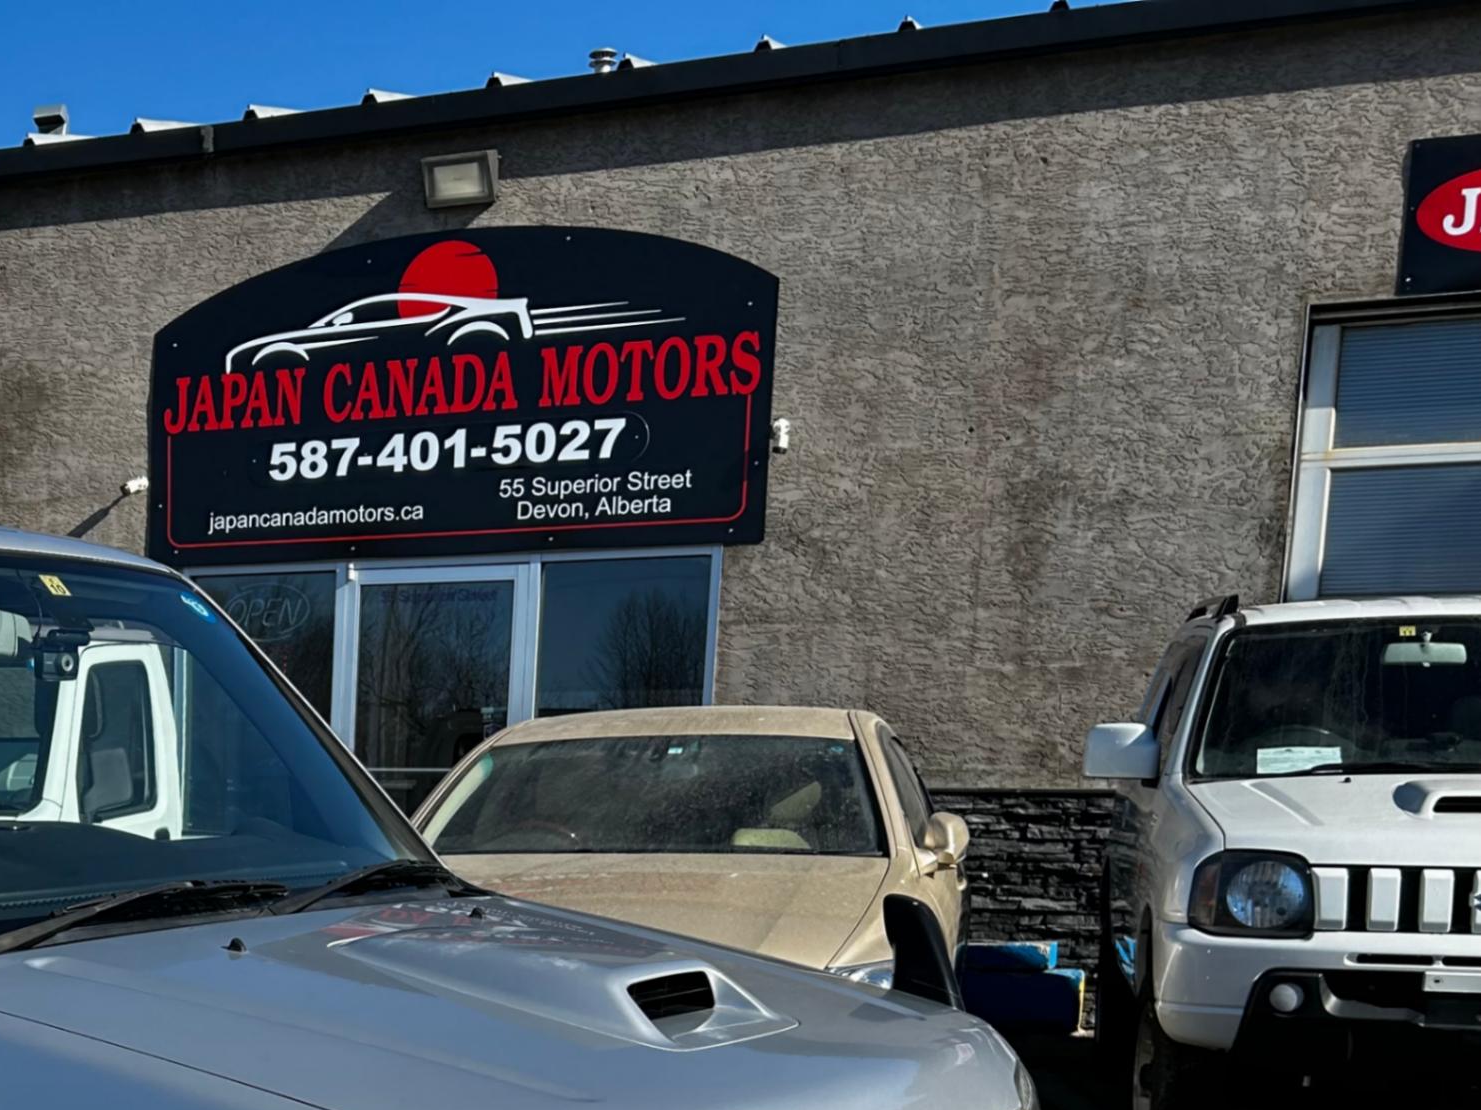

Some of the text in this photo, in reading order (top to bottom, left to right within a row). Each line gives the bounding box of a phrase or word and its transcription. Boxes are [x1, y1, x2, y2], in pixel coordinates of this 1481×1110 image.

[1442, 187, 1481, 236] J
[164, 331, 761, 434] JAPAN CANADA MOTORS
[268, 417, 627, 482] 587-401-5027
[499, 469, 692, 500] 55 Superior Street
[208, 505, 424, 535] japancanadamotors.ca
[517, 495, 671, 520] Devon, Alberta
[228, 598, 303, 627] OPEN
